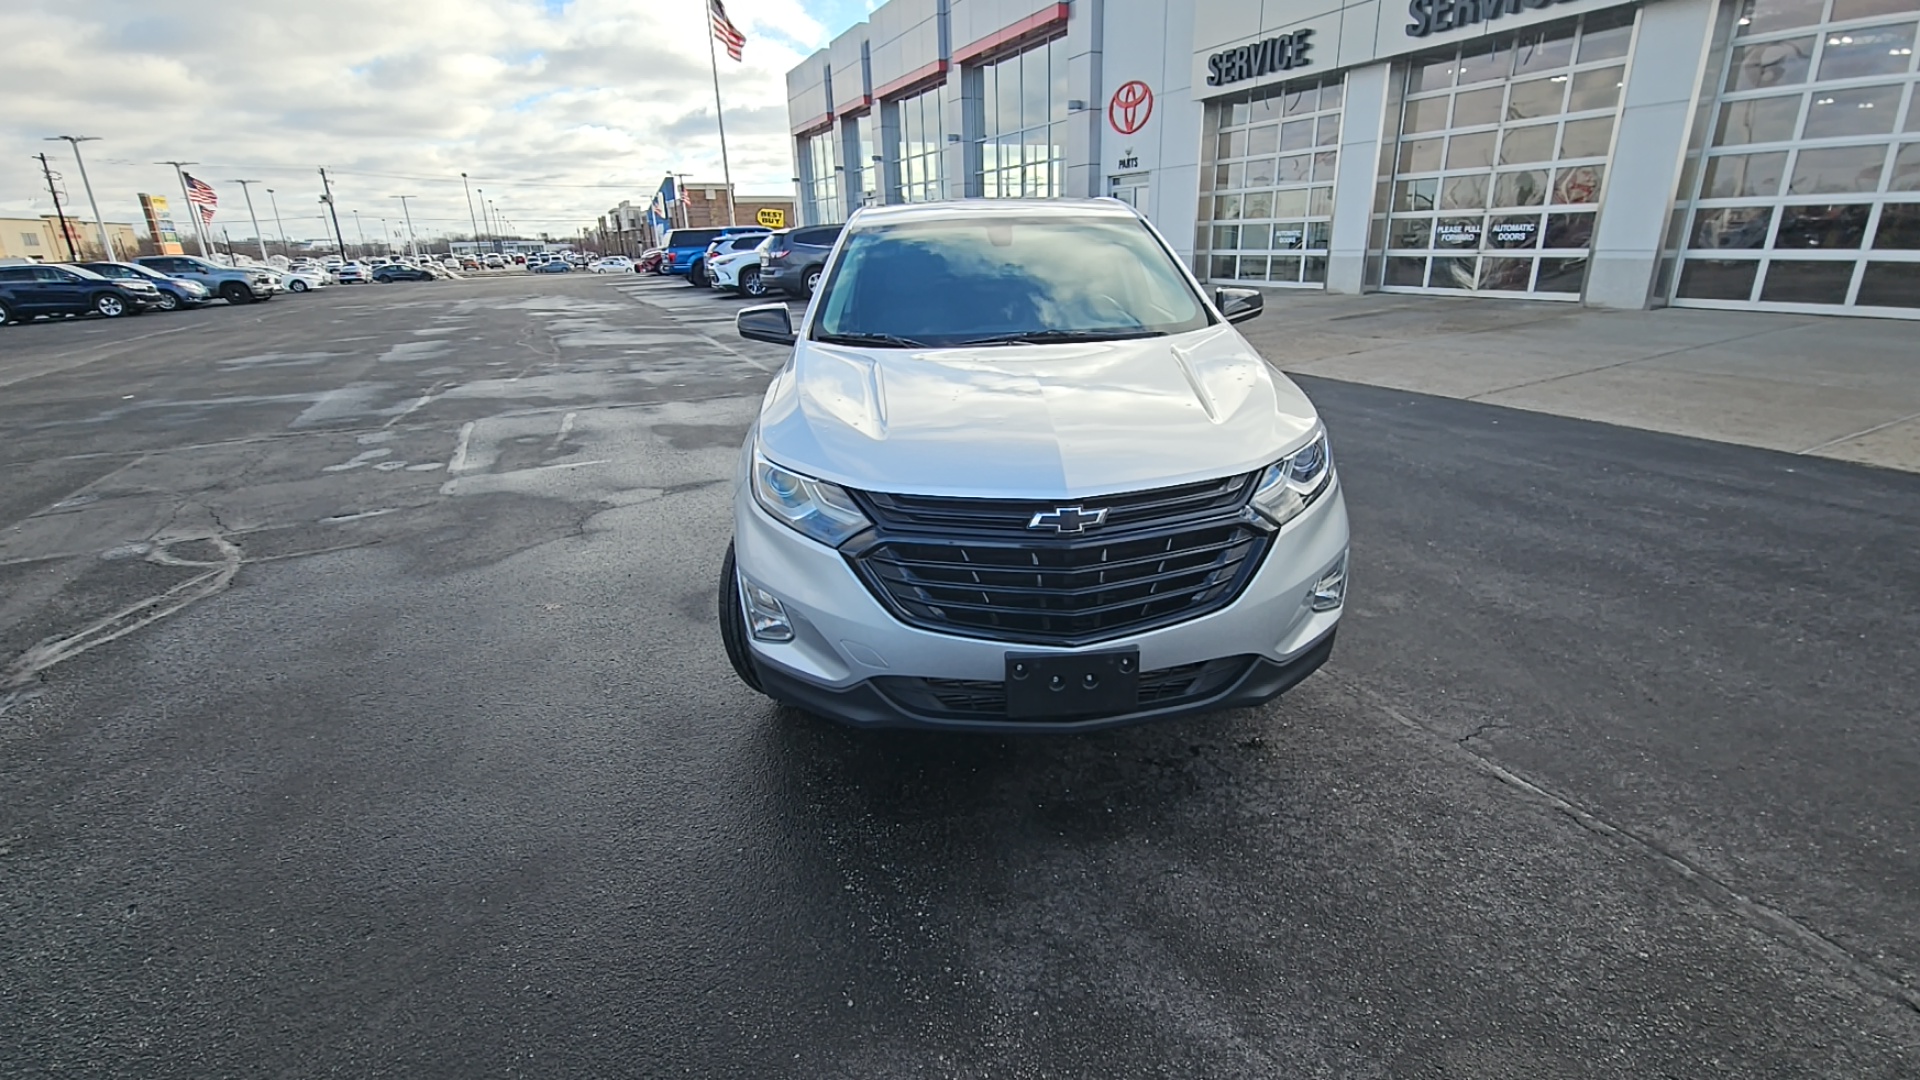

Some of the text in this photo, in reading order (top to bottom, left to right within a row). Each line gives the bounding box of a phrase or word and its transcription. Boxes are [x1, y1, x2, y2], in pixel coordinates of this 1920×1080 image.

[1206, 28, 1316, 86] SERVICE
[1118, 157, 1138, 170] PARTS
[1437, 224, 1481, 233] PLEASE PULL
[1492, 224, 1535, 232] AUTOMATIC
